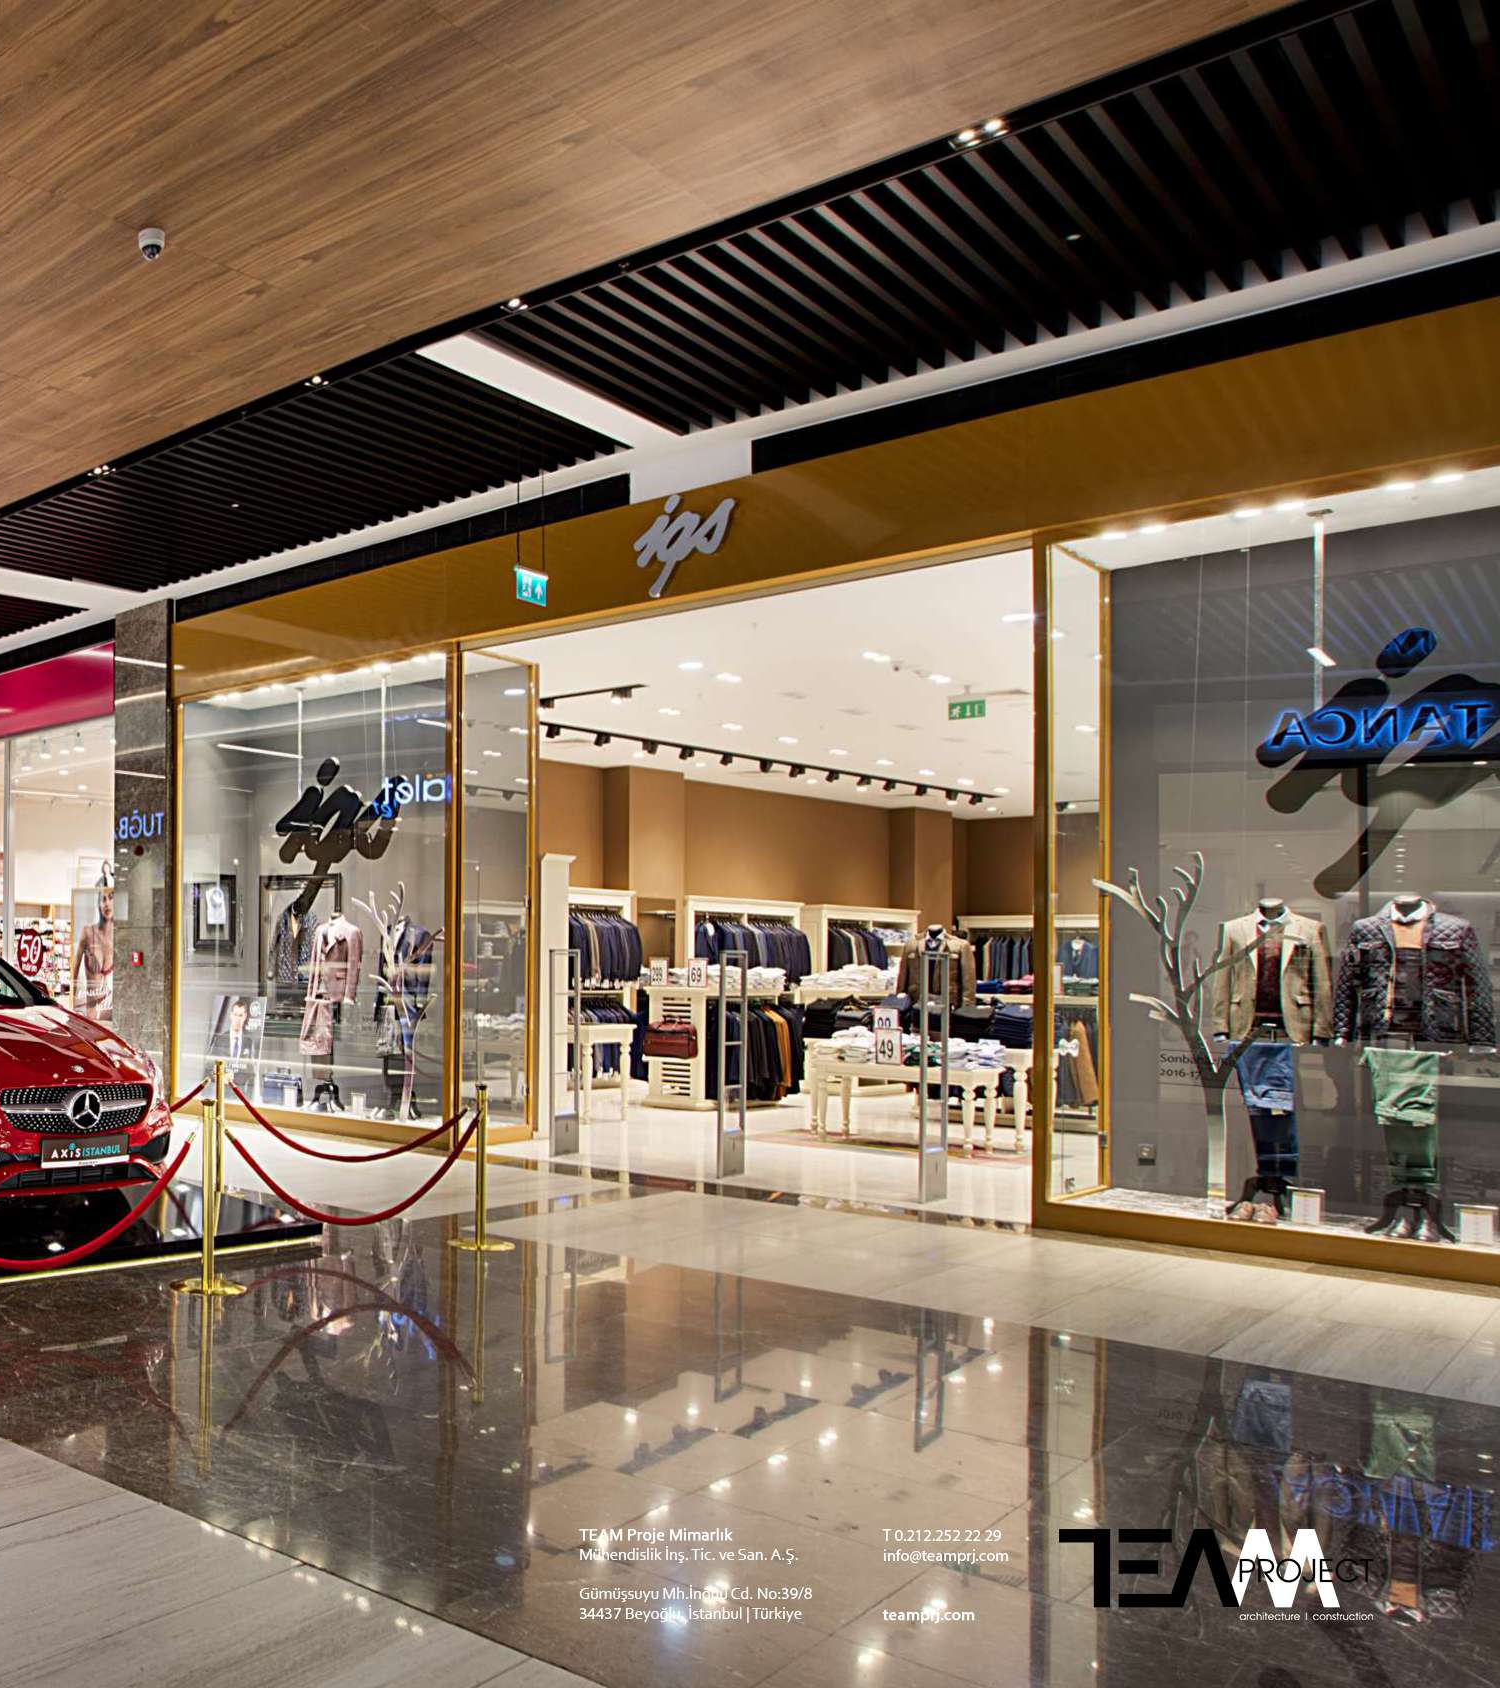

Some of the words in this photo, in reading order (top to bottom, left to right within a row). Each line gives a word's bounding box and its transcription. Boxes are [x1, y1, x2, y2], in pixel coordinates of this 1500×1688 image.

[20, 933, 42, 965] 50
[691, 967, 702, 983] 69
[880, 1039, 894, 1058] 49
